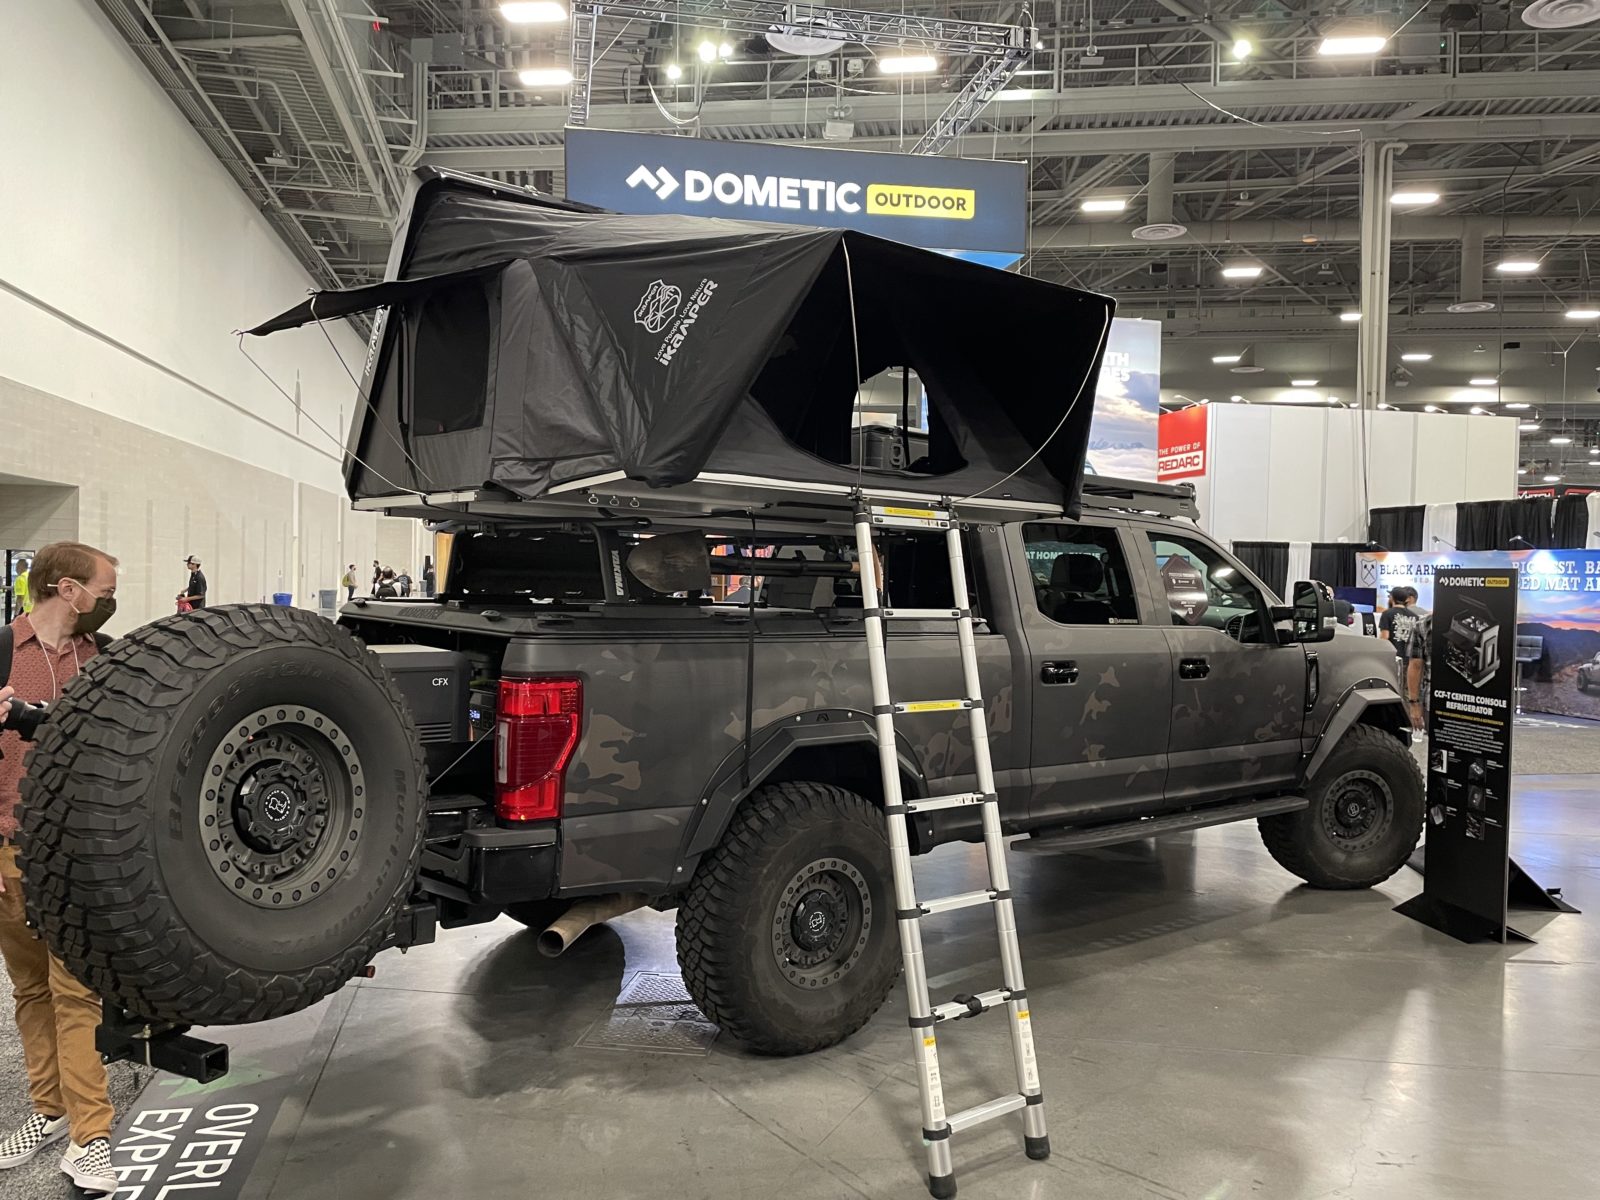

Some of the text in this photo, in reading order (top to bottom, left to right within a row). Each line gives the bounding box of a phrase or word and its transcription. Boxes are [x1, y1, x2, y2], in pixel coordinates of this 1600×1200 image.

[684, 169, 968, 214] DOMETIC OUTDOOR
[654, 343, 667, 361] Love
[679, 301, 693, 318] Love
[690, 278, 708, 301] Nature
[1159, 441, 1201, 455] THE POWER OF
[1158, 454, 1201, 472] REDARC
[1379, 564, 1413, 576] BLACK
[1449, 576, 1485, 587] DOMETIC
[1544, 576, 1580, 591] MAT
[432, 677, 449, 687] CFX
[1434, 690, 1507, 708] CCF-T CENTER CONSOLE
[1445, 701, 1493, 716] REFRIGERATOR
